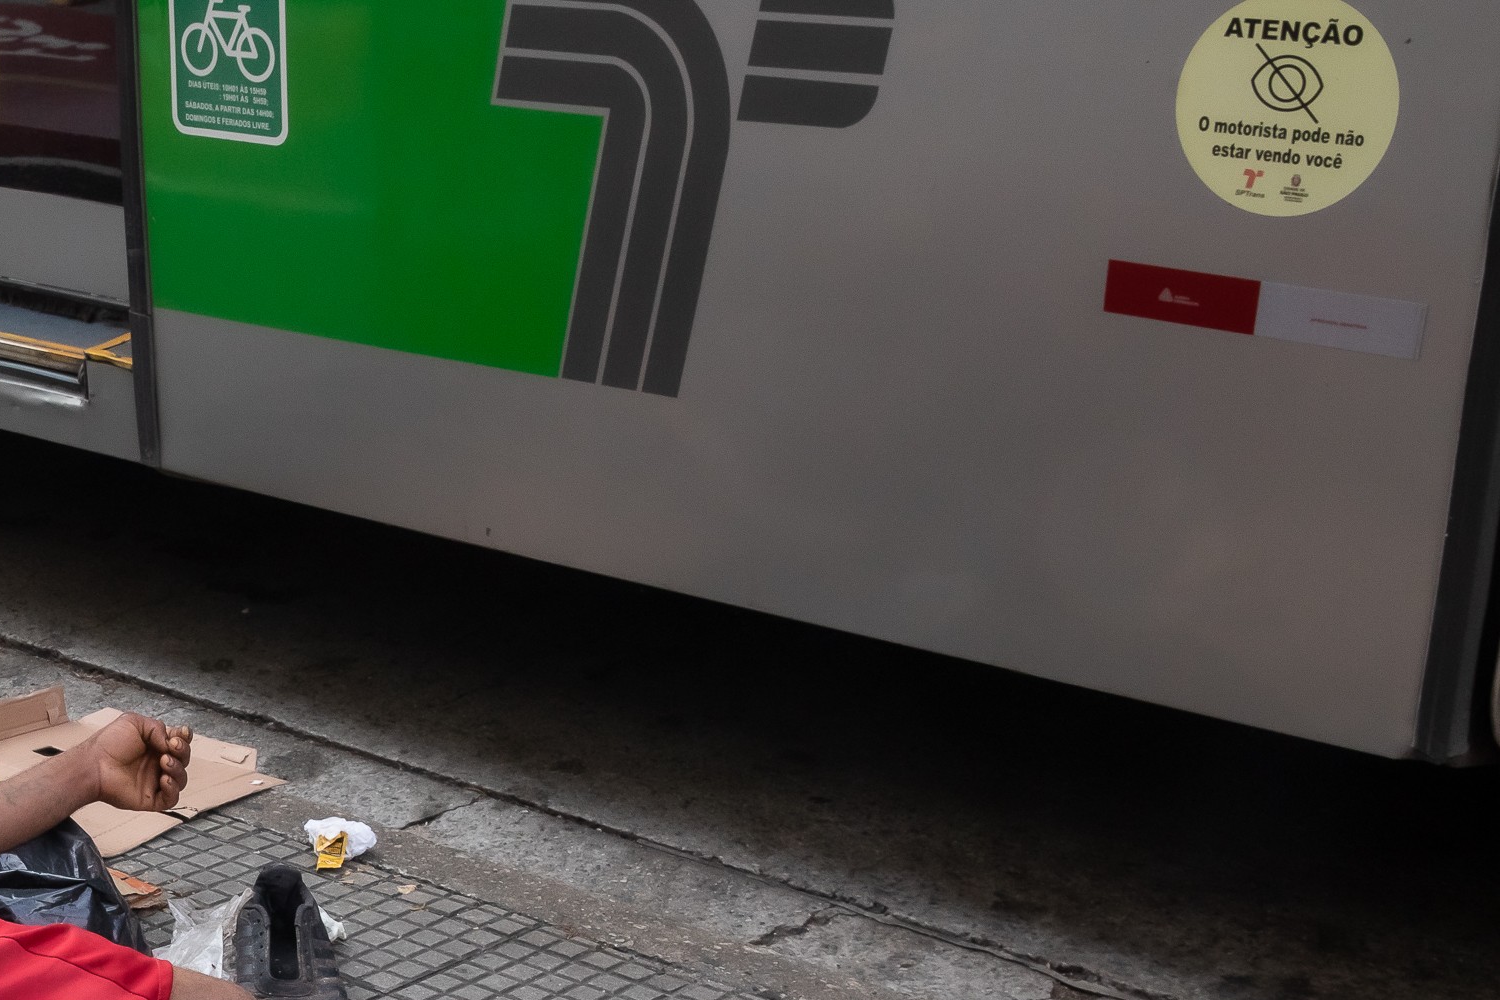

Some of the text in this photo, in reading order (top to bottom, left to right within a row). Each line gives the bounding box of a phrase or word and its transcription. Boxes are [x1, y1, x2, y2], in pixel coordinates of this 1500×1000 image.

[1224, 17, 1364, 49] ATENÇÃO
[188, 80, 202, 88] DIAS
[220, 105, 241, 114] PARTIR
[242, 108, 255, 116] DAS
[186, 114, 216, 124] DOMINGOS
[222, 118, 251, 128] FERIADOS
[1199, 116, 1364, 147] O motorista pode não
[1212, 143, 1343, 169] estar vendo você
